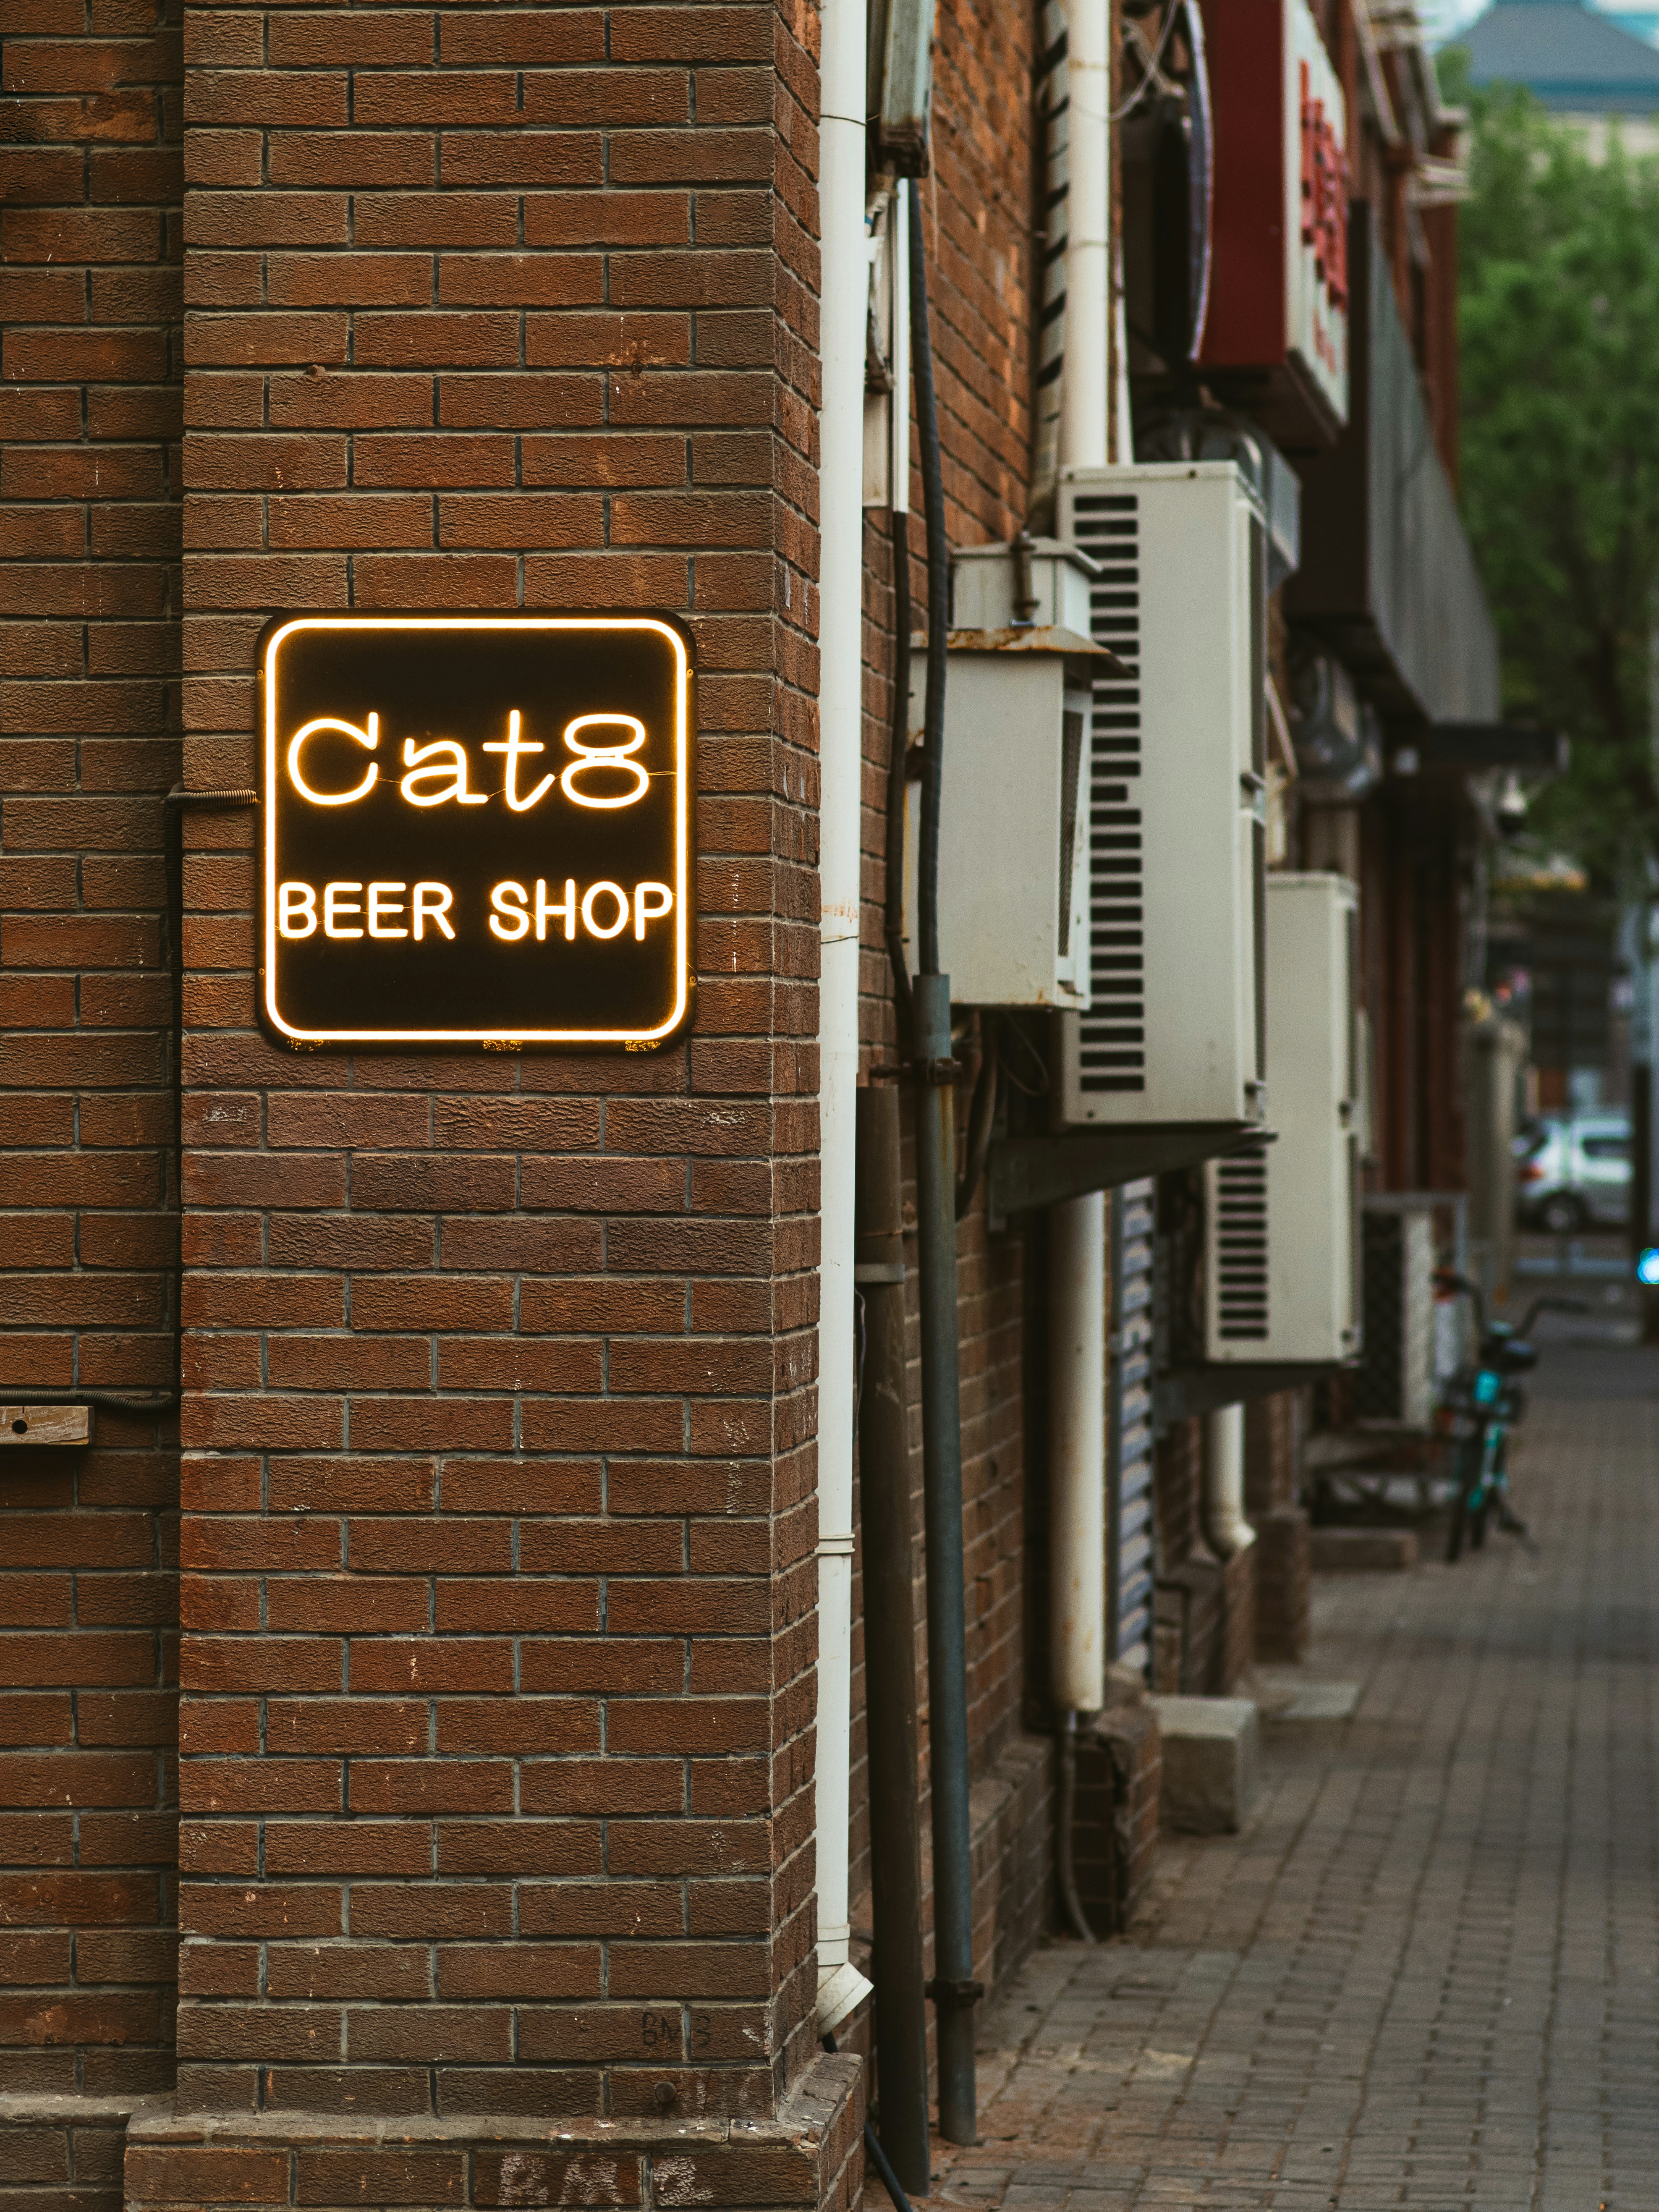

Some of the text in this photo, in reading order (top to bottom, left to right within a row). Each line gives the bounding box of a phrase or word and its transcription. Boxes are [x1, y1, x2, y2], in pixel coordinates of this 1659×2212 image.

[287, 709, 649, 811] Cat8
[279, 879, 673, 940] BEER SHOP
